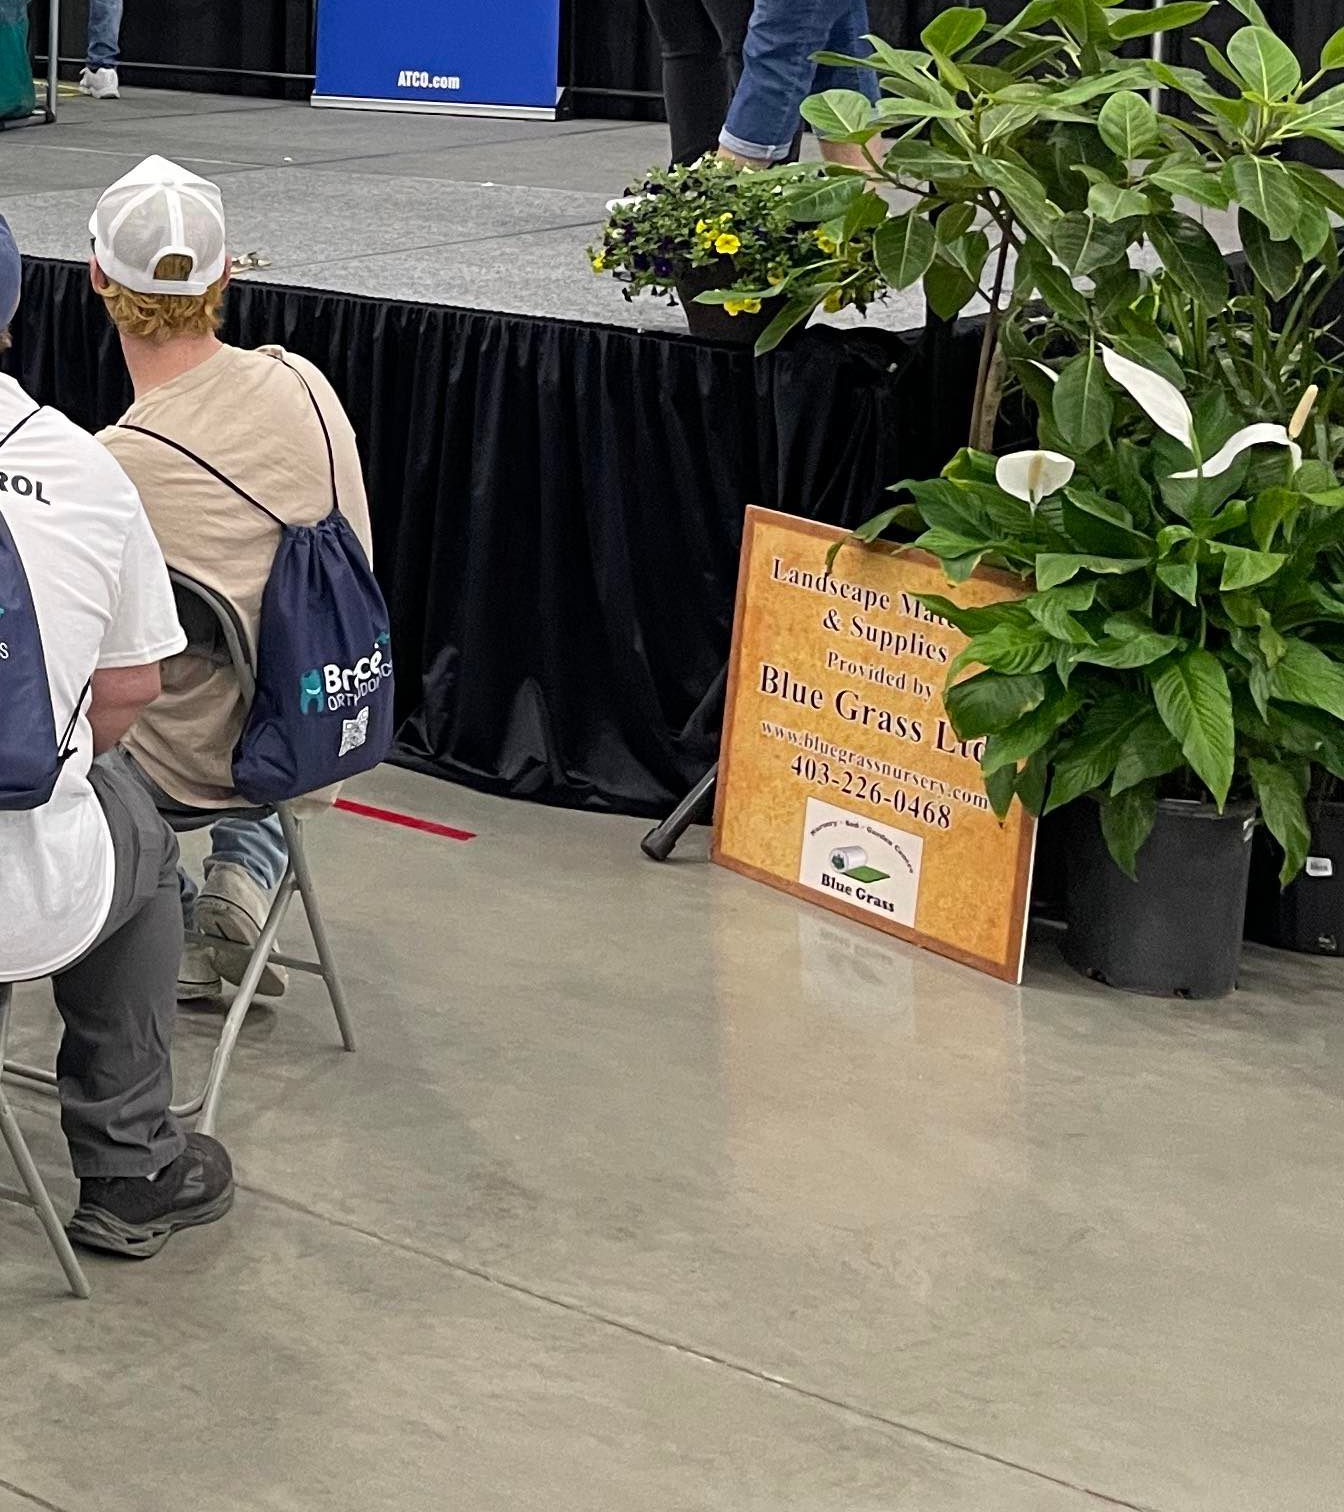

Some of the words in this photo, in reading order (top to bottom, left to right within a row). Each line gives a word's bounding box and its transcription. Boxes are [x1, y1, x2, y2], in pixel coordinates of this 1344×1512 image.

[397, 70, 460, 90] ATCO.com
[772, 557, 890, 611] Landscape
[822, 608, 841, 632] &
[850, 614, 949, 664] Supplies
[760, 663, 824, 710] Blue
[835, 689, 923, 744] Grass
[826, 651, 906, 690] Provided
[913, 677, 933, 702] by
[762, 721, 989, 810] www.bluegrassnursery.com
[790, 754, 953, 830] 403-226-0468
[821, 873, 853, 896] Blue
[855, 887, 895, 913] Grass
